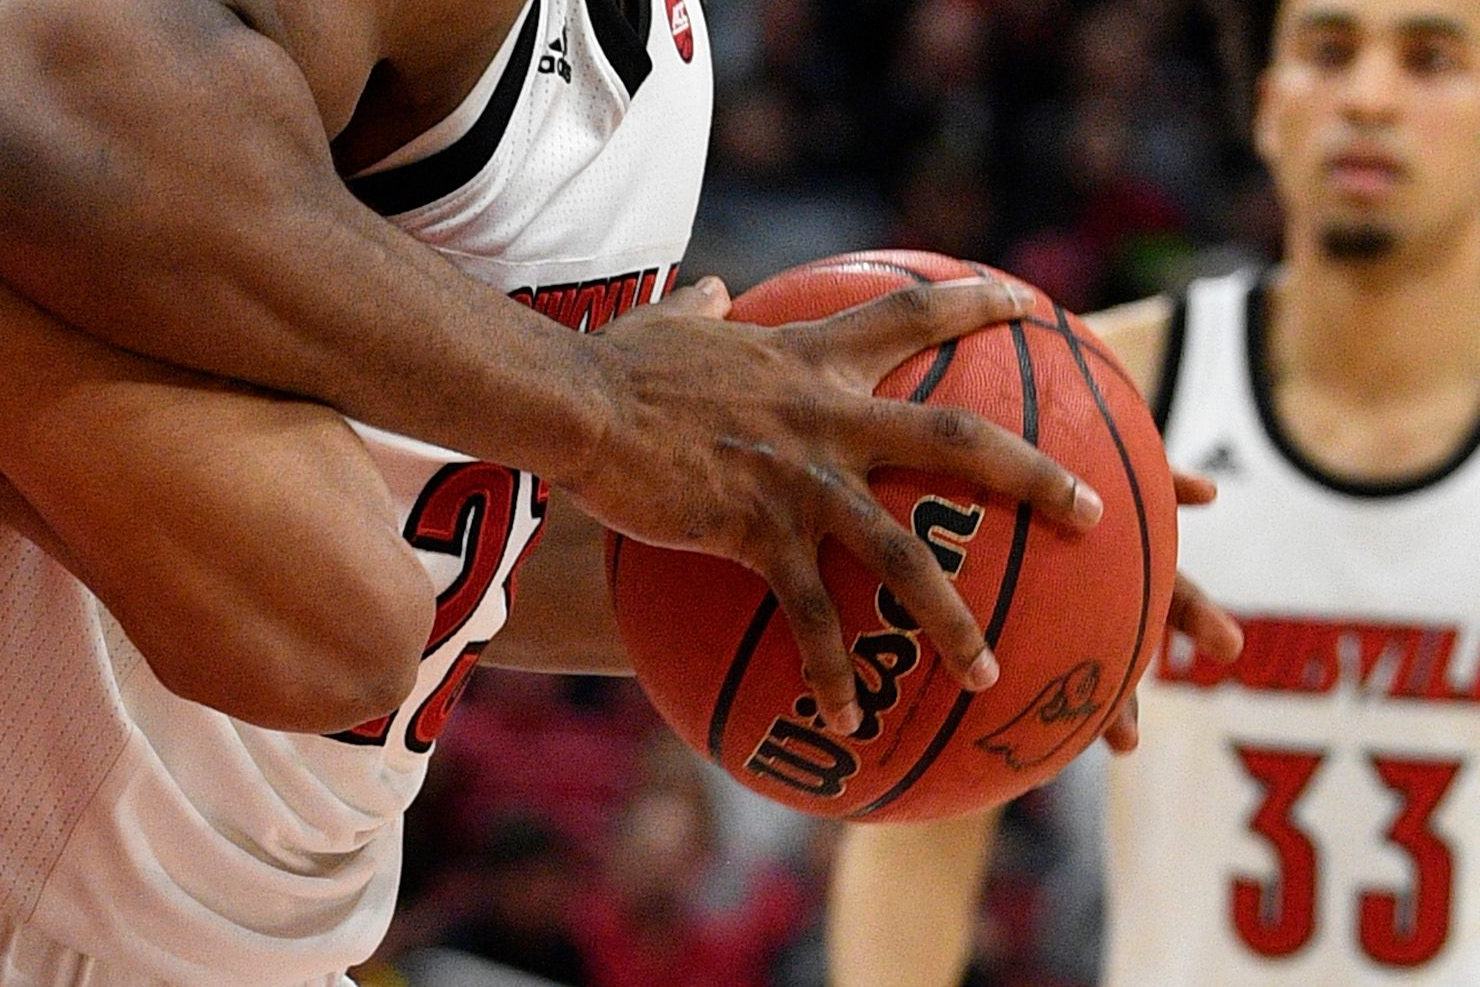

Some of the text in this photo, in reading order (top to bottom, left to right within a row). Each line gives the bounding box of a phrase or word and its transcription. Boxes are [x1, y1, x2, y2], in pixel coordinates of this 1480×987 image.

[323, 460, 551, 753] 2
[742, 494, 986, 799] Wsn
[1225, 734, 1465, 969] 33
